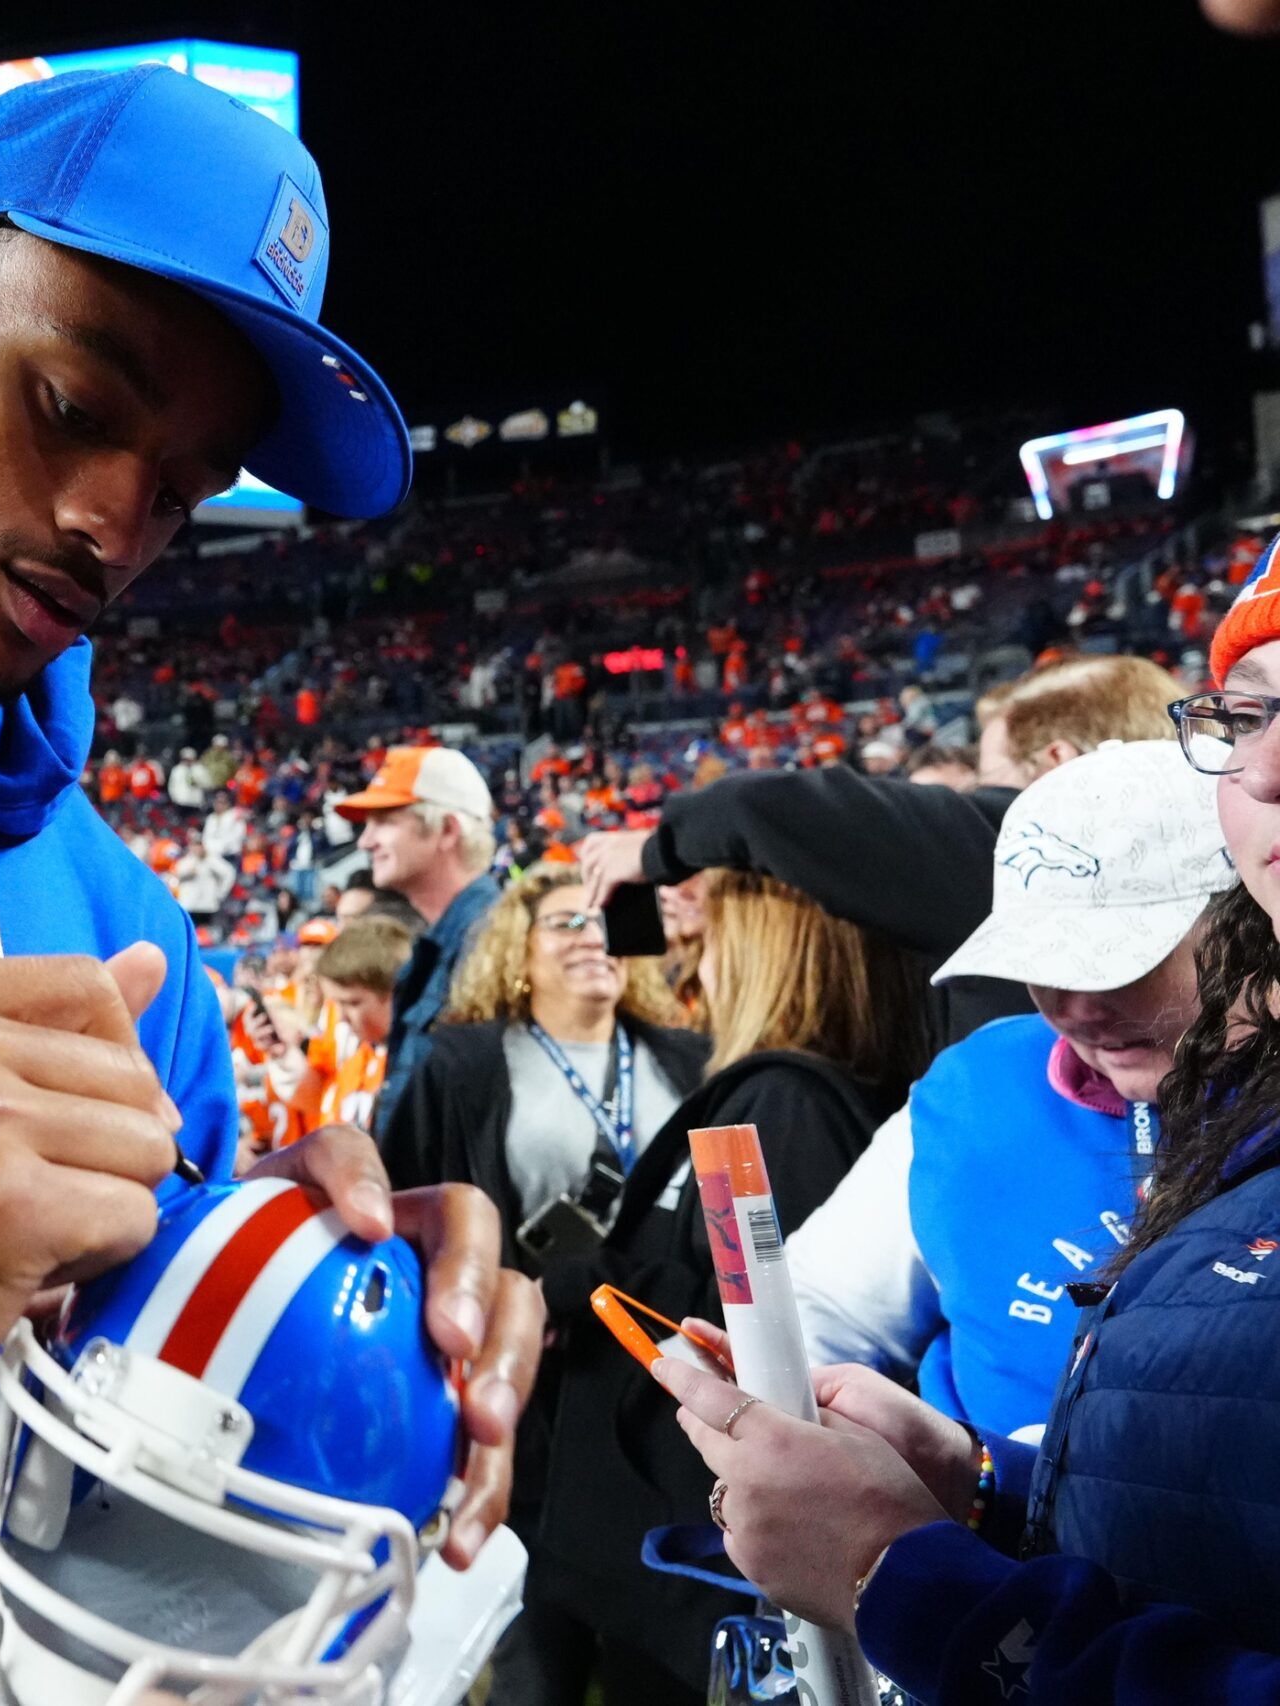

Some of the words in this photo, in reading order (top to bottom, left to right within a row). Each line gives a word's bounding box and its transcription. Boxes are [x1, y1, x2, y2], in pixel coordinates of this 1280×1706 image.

[265, 241, 304, 297] BRONCOS
[1008, 1272, 1065, 1325] BE
[1052, 1238, 1095, 1271] A
